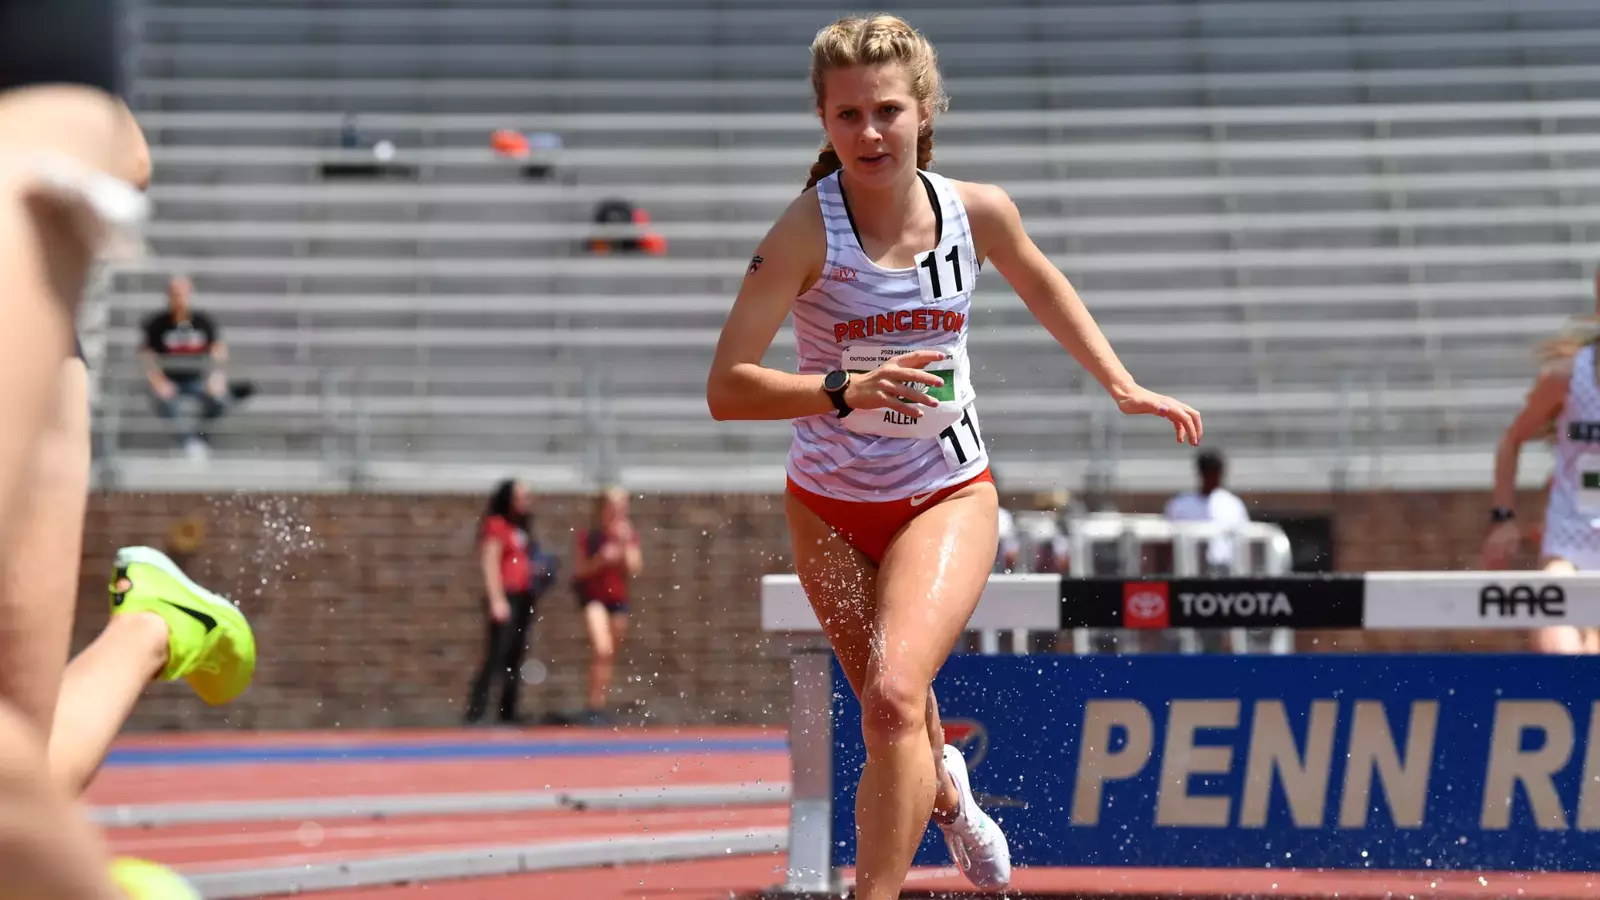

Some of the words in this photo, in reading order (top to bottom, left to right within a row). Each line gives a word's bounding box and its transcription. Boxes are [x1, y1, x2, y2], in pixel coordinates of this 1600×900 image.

[839, 268, 857, 278] IVY
[920, 244, 964, 299] 11
[833, 309, 966, 343] PRINCETON
[883, 410, 918, 425] ALLEN
[938, 408, 981, 465] 11
[1178, 591, 1294, 617] TOYOTA
[1068, 698, 1440, 828] PENN
[1481, 698, 1600, 831] R
